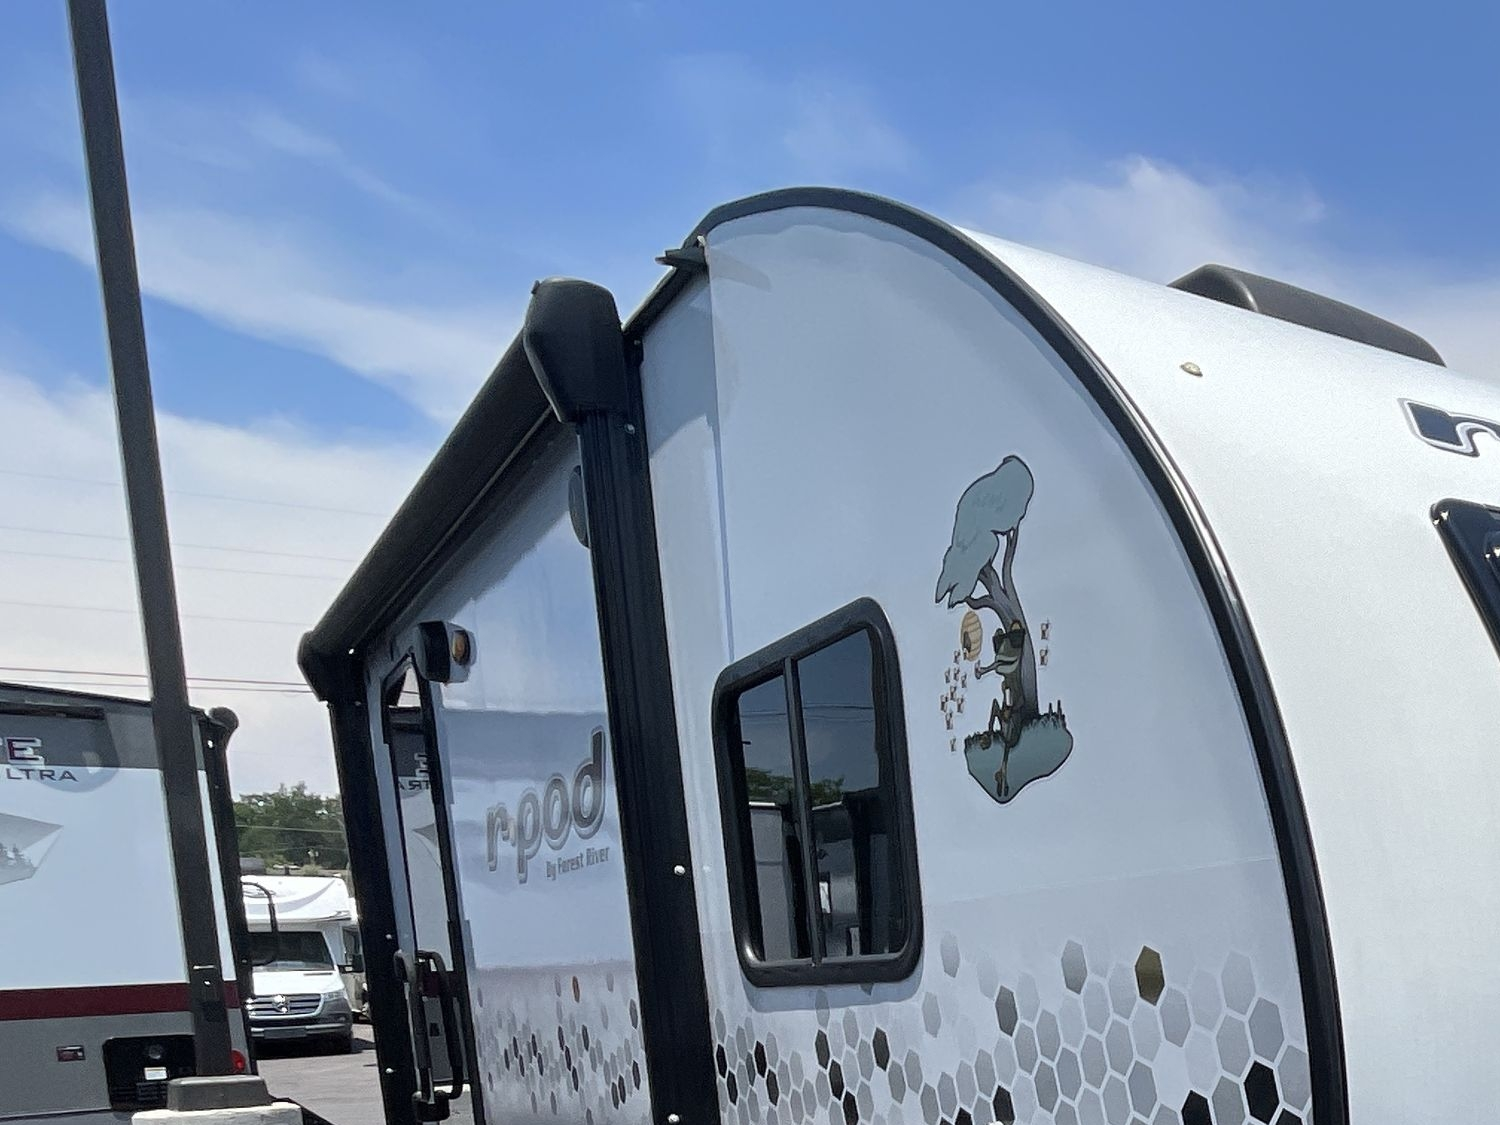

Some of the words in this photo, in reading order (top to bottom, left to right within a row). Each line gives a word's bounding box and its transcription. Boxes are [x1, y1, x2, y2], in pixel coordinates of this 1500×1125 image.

[0, 736, 45, 769] E
[558, 852, 584, 875] Forest
[586, 847, 610, 867] River
